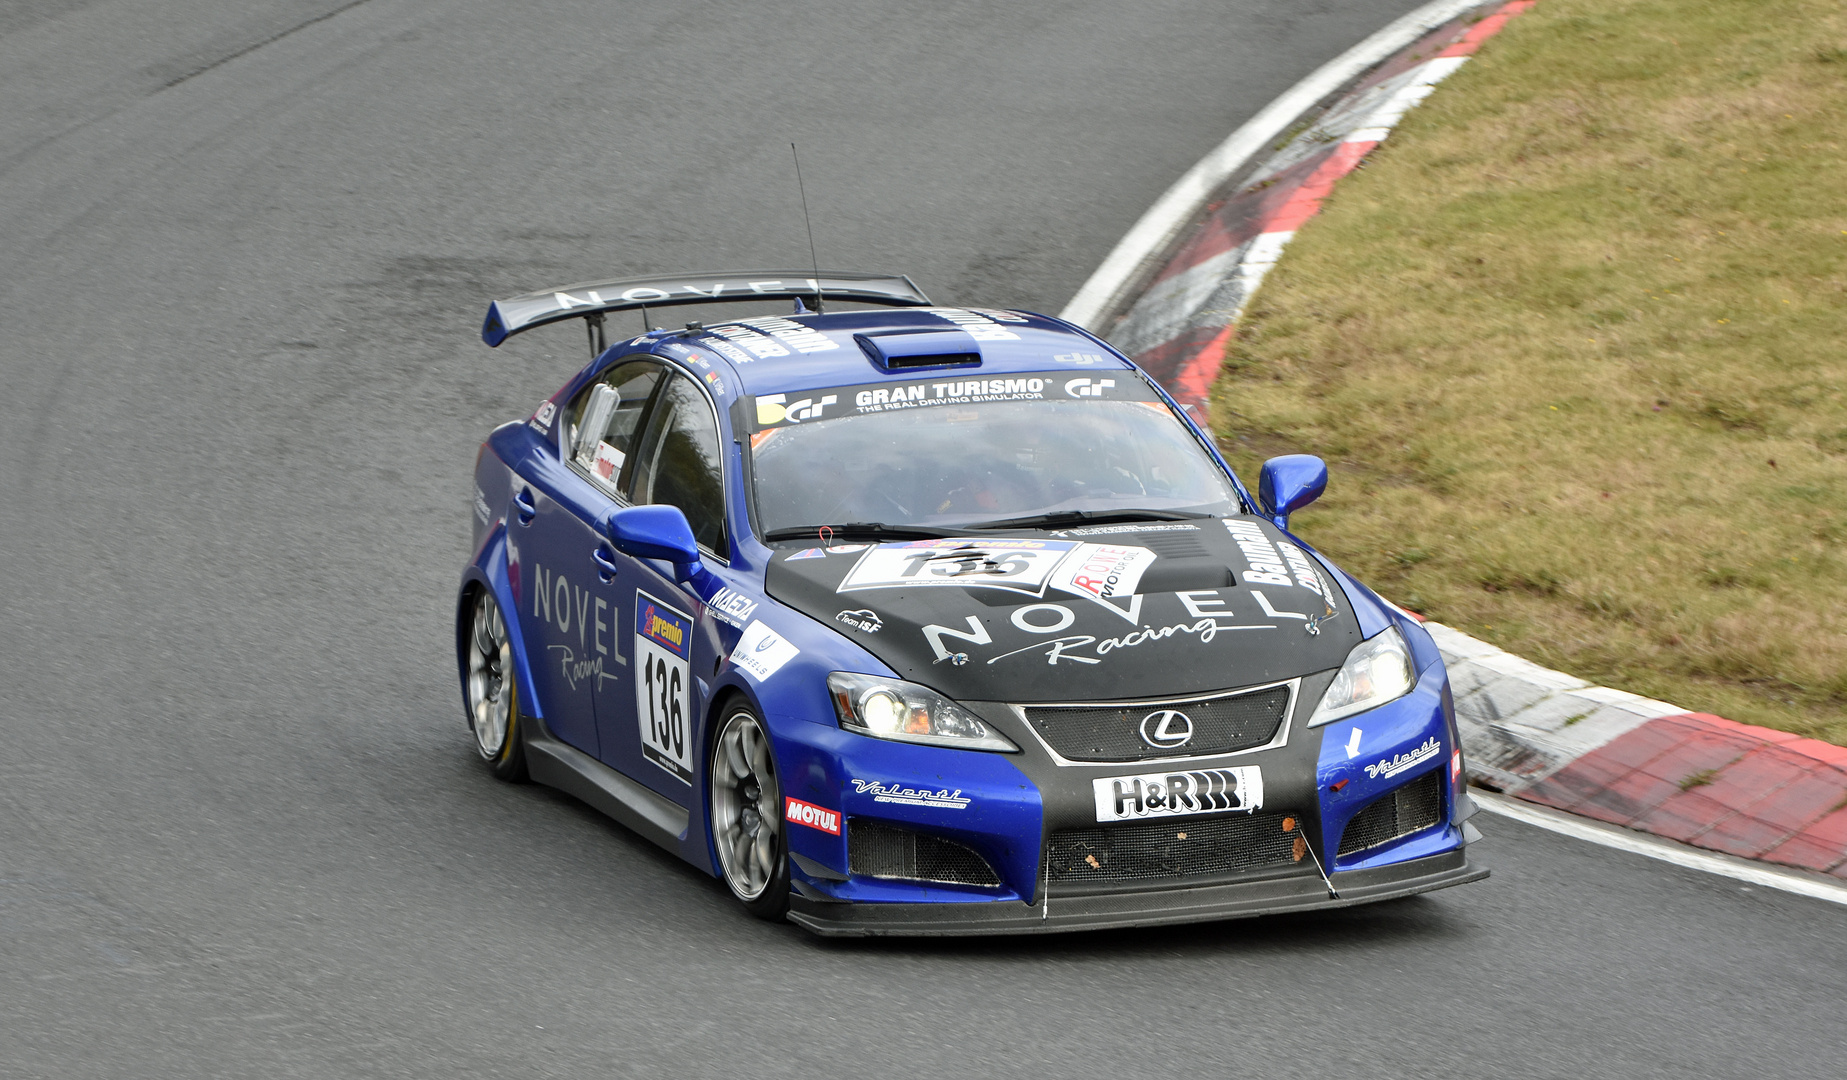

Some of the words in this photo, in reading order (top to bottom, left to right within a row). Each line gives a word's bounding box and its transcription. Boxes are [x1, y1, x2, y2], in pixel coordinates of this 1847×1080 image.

[554, 279, 848, 310] NOVEL
[855, 385, 926, 407] GRAN
[856, 405, 883, 414] THE
[884, 401, 918, 411] REAL
[918, 397, 970, 407] DRIVING
[972, 393, 1043, 403] SIMULATOR
[1074, 548, 1127, 594] ROWE
[1221, 519, 1293, 586] Baumann
[1100, 562, 1129, 598] MOTOR
[1123, 552, 1139, 561] OIL
[534, 563, 627, 667] NOVEL
[708, 586, 759, 622] MAEDA
[840, 614, 859, 628] Team
[859, 619, 883, 634] ISF
[651, 614, 683, 646] premio
[921, 590, 1308, 662] NOVEL
[987, 618, 1277, 664] Racing
[547, 644, 618, 692] Racing
[644, 652, 684, 760] 136
[1364, 736, 1440, 779] Valenti
[851, 779, 971, 803] Valenti
[787, 801, 839, 832] MOTUL
